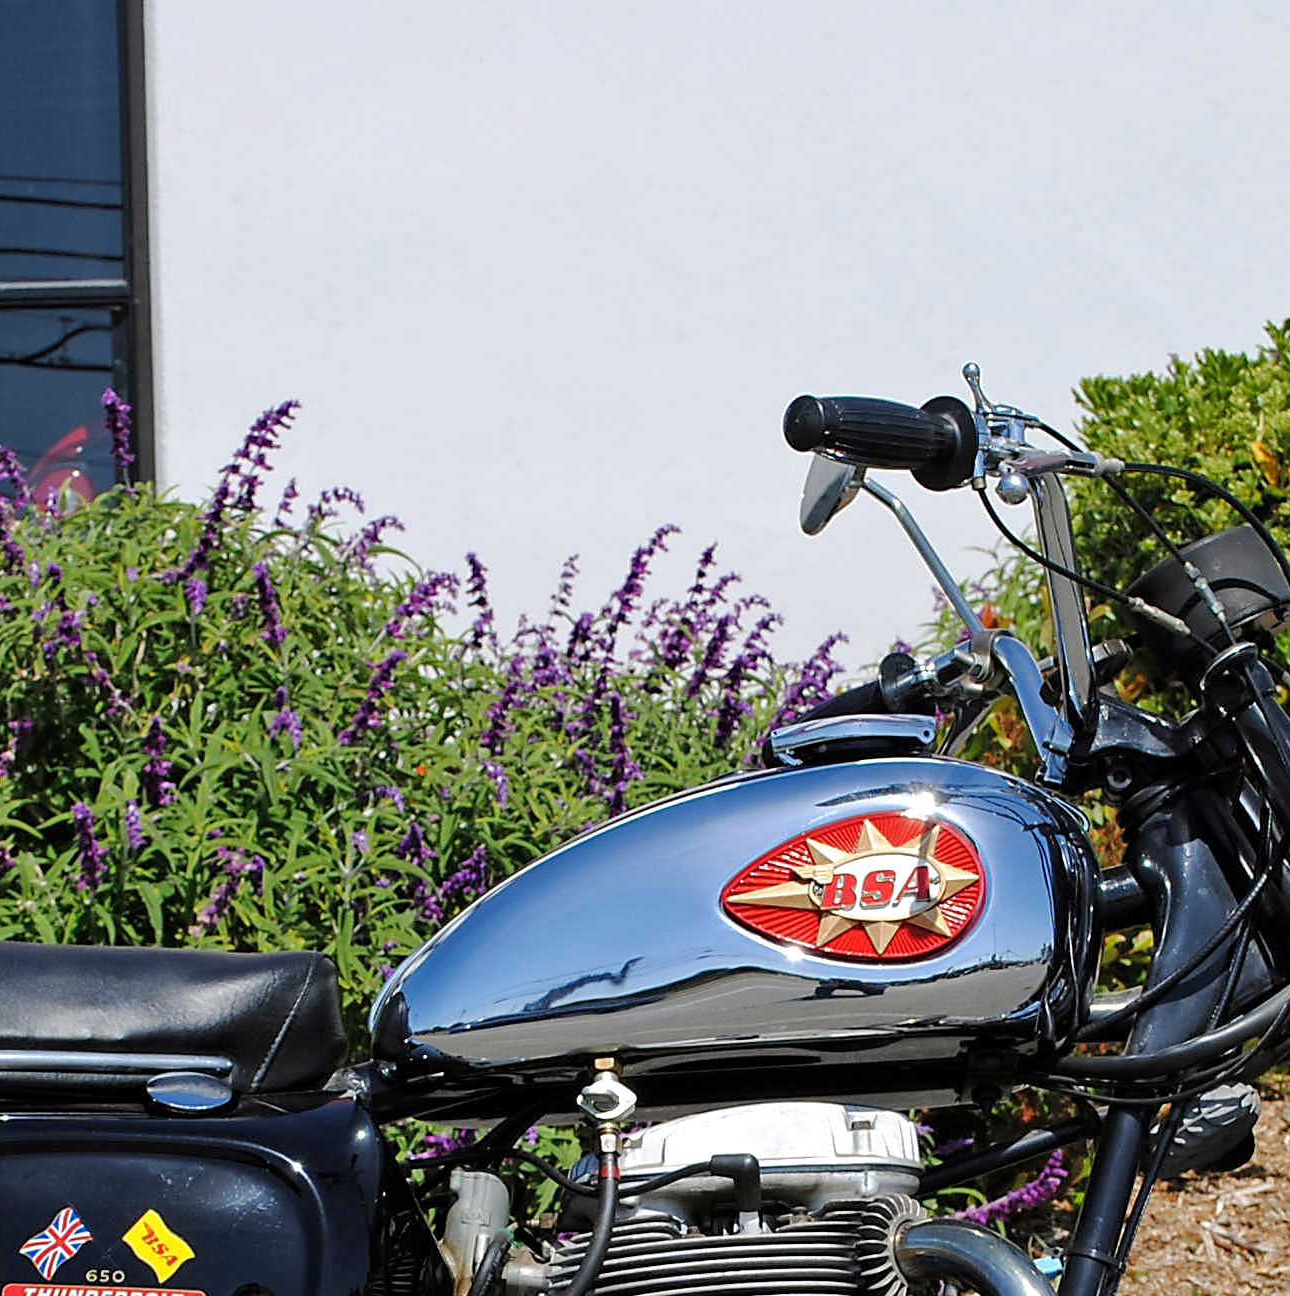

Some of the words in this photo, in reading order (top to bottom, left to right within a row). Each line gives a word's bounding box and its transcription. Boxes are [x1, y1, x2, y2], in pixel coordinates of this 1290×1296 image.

[819, 865, 932, 911] BSA
[141, 1223, 178, 1266] BSA
[85, 1270, 125, 1283] 650
